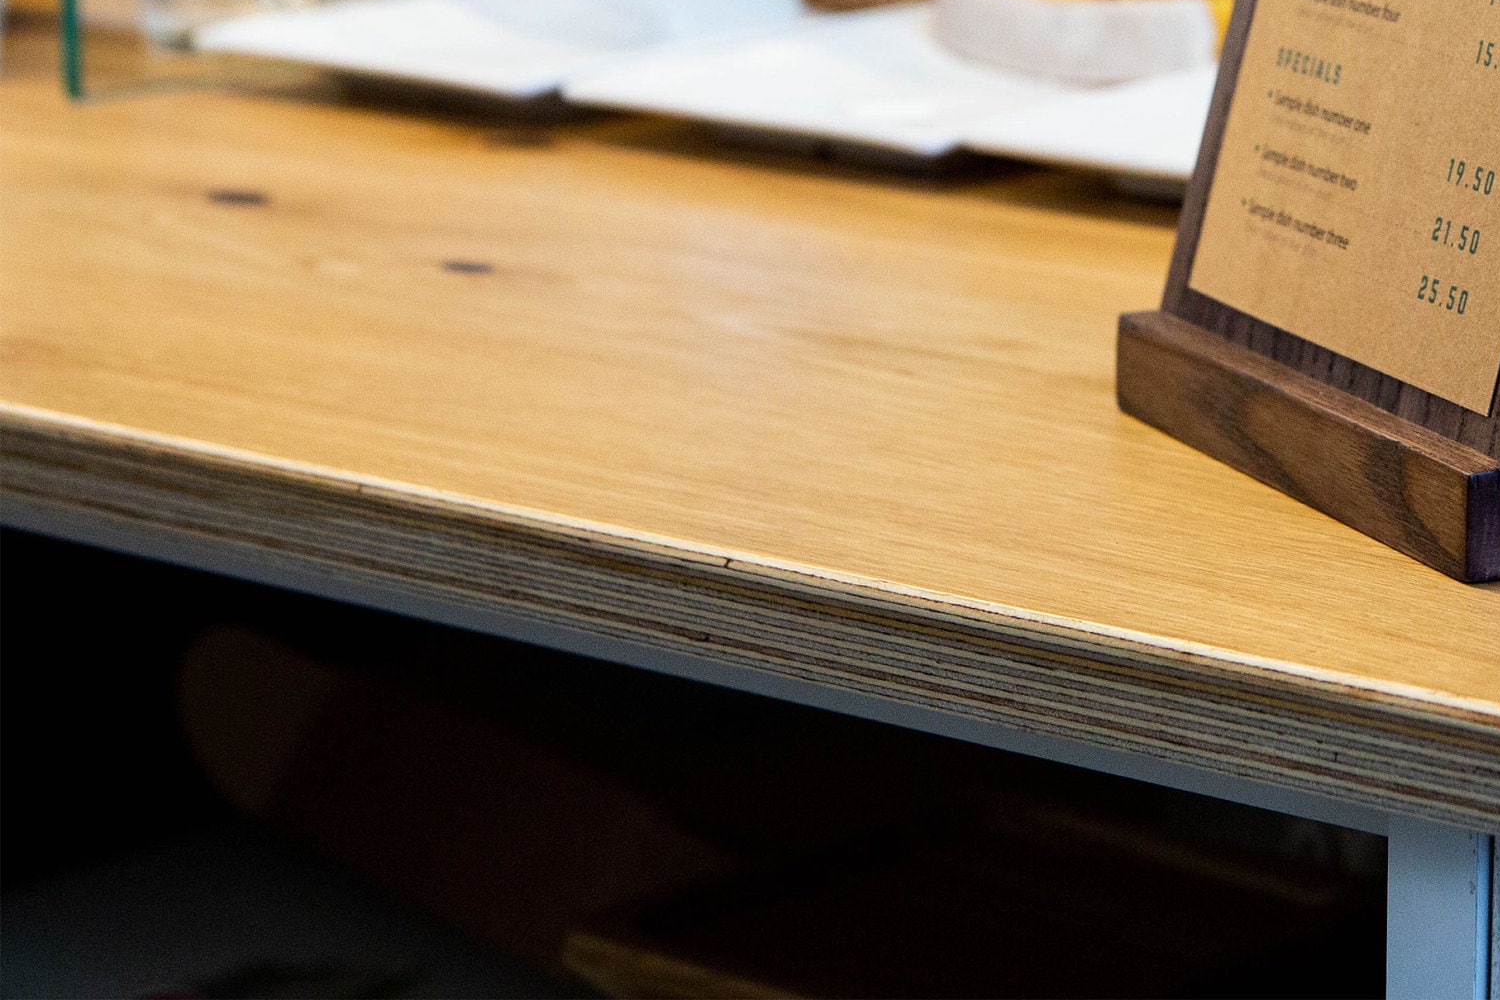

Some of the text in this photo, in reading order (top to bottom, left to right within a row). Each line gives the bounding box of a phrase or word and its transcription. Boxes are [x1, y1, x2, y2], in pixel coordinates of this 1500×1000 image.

[1349, 0, 1381, 18] number
[1276, 47, 1342, 85] SPECIALS
[1321, 108, 1354, 128] number
[1308, 163, 1339, 184] number
[1447, 158, 1496, 196] 19.50
[1294, 219, 1325, 241] number
[1431, 217, 1481, 255] 21.50
[1417, 275, 1469, 315] 25.50
